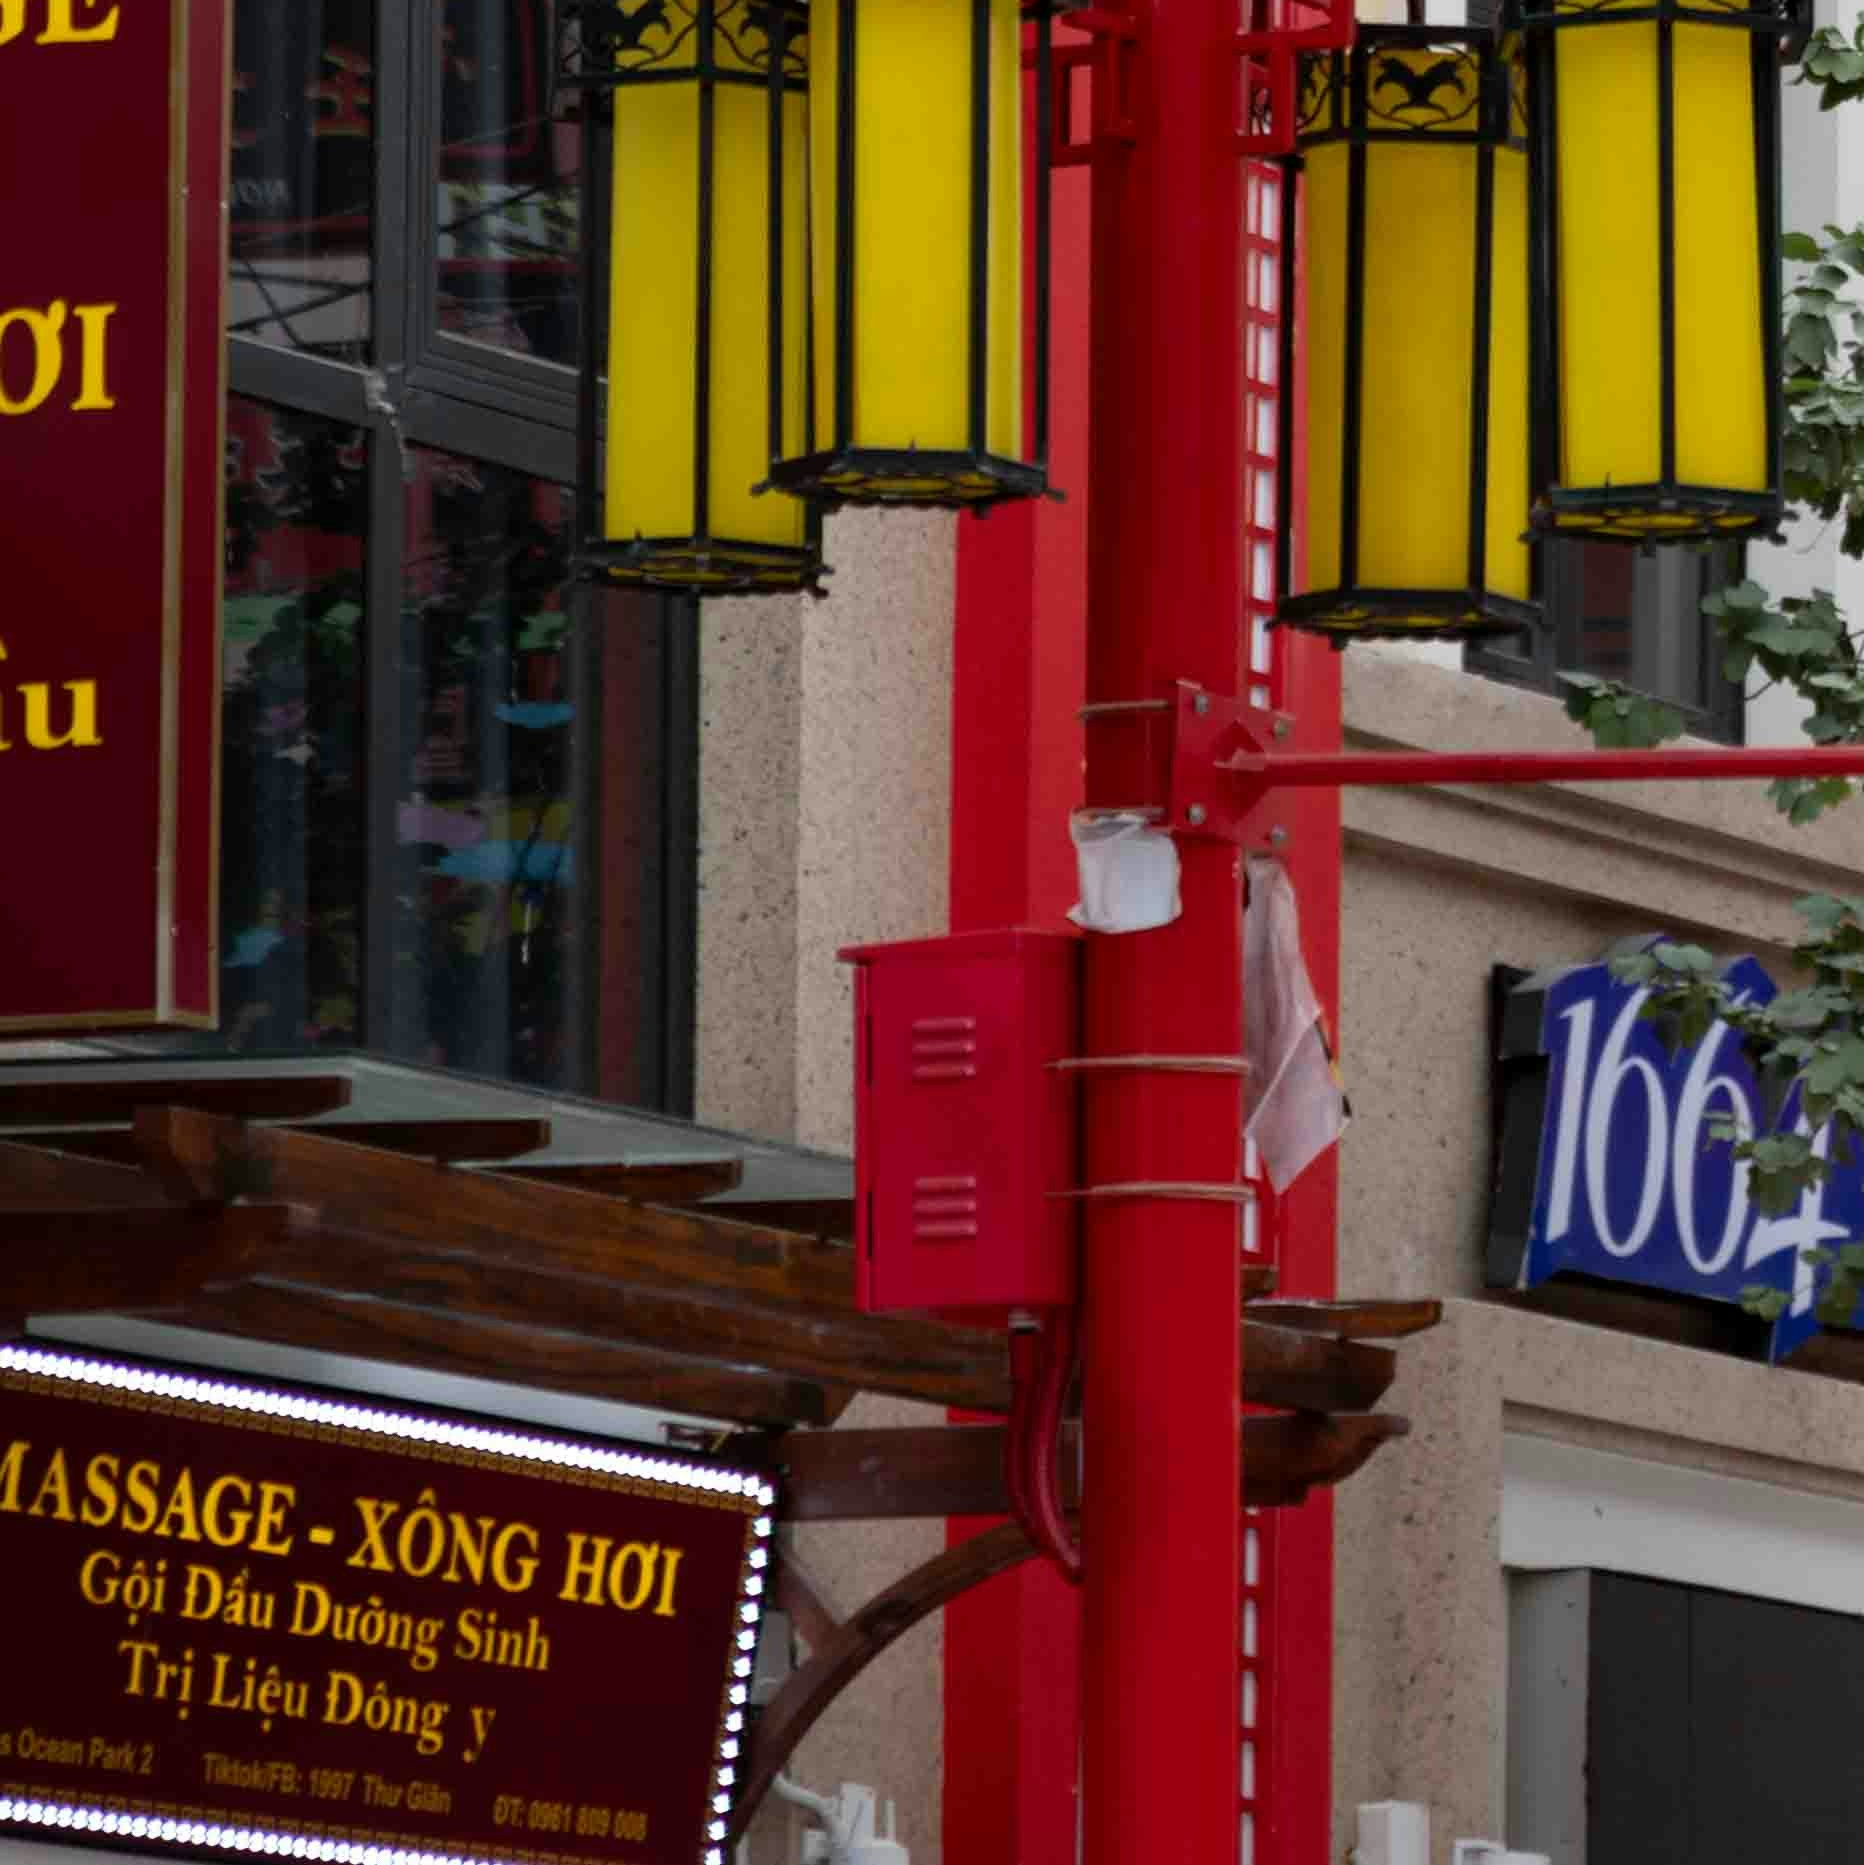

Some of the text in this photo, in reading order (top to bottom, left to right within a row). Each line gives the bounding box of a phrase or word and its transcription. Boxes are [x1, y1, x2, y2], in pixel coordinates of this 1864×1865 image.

[79, 1549, 166, 1626] Gội
[180, 1563, 275, 1630] Đầu
[455, 1606, 551, 1671] Sinh
[348, 1487, 540, 1593] XÔNG
[558, 1530, 685, 1617] HƠI
[89, 1737, 133, 1774] Park
[117, 1639, 195, 1720] Trị
[208, 1652, 310, 1733] Liệu
[322, 1669, 452, 1755] Đông
